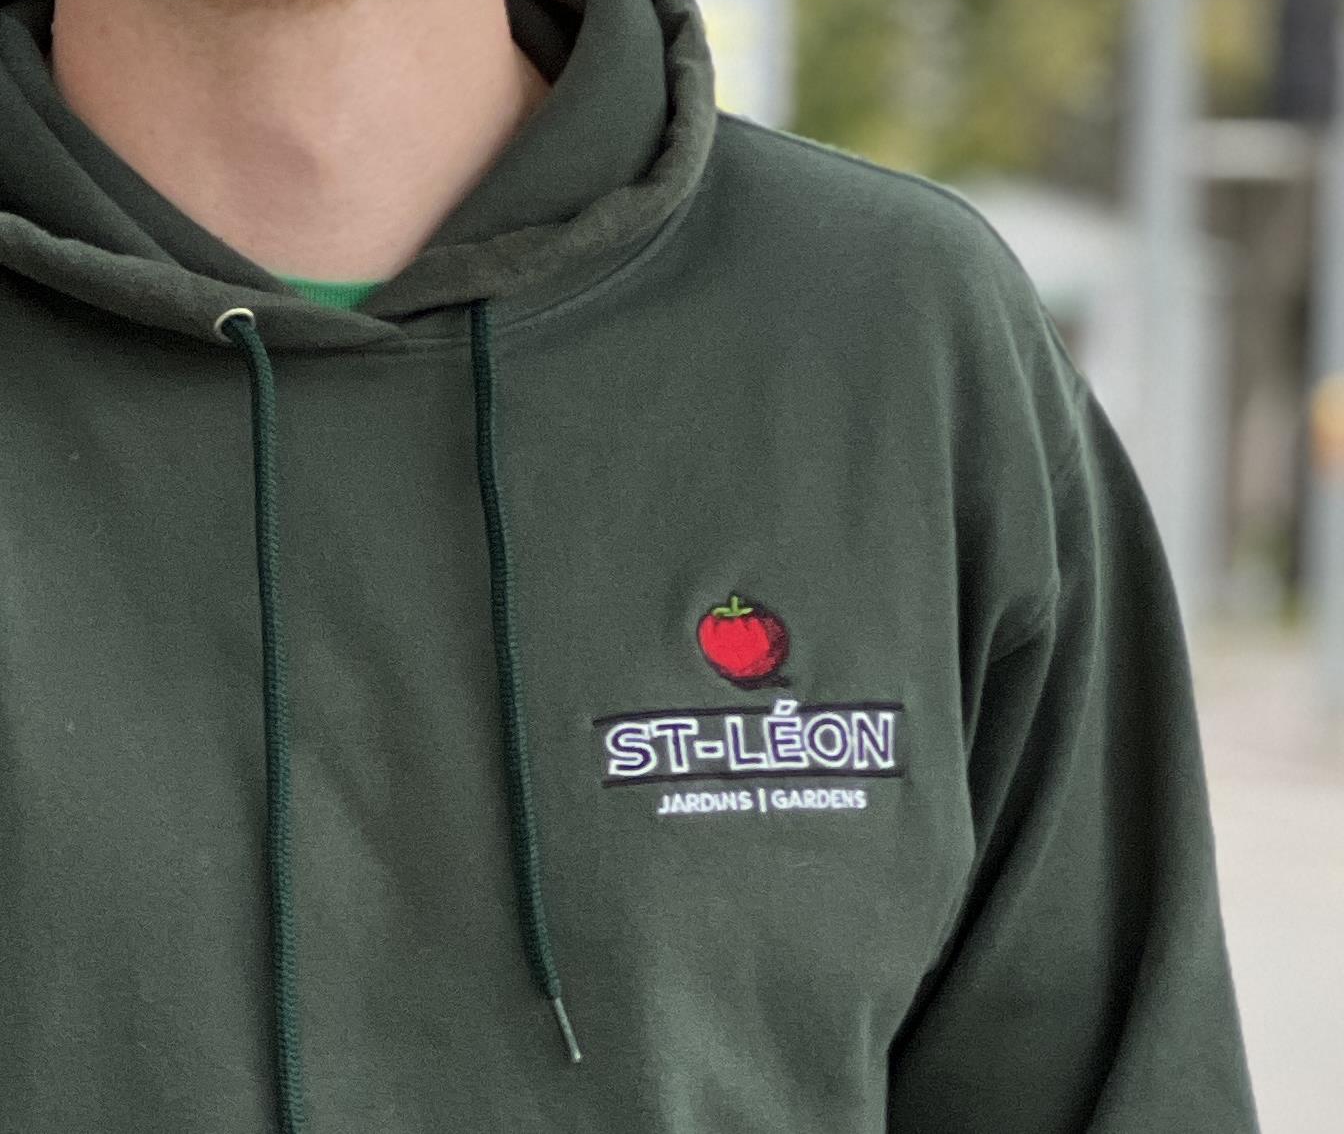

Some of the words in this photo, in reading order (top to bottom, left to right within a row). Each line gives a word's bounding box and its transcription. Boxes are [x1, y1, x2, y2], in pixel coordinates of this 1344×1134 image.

[606, 699, 895, 776] ST-LÉON
[658, 790, 753, 814] JARDINS
[770, 789, 868, 809] GARDENS
